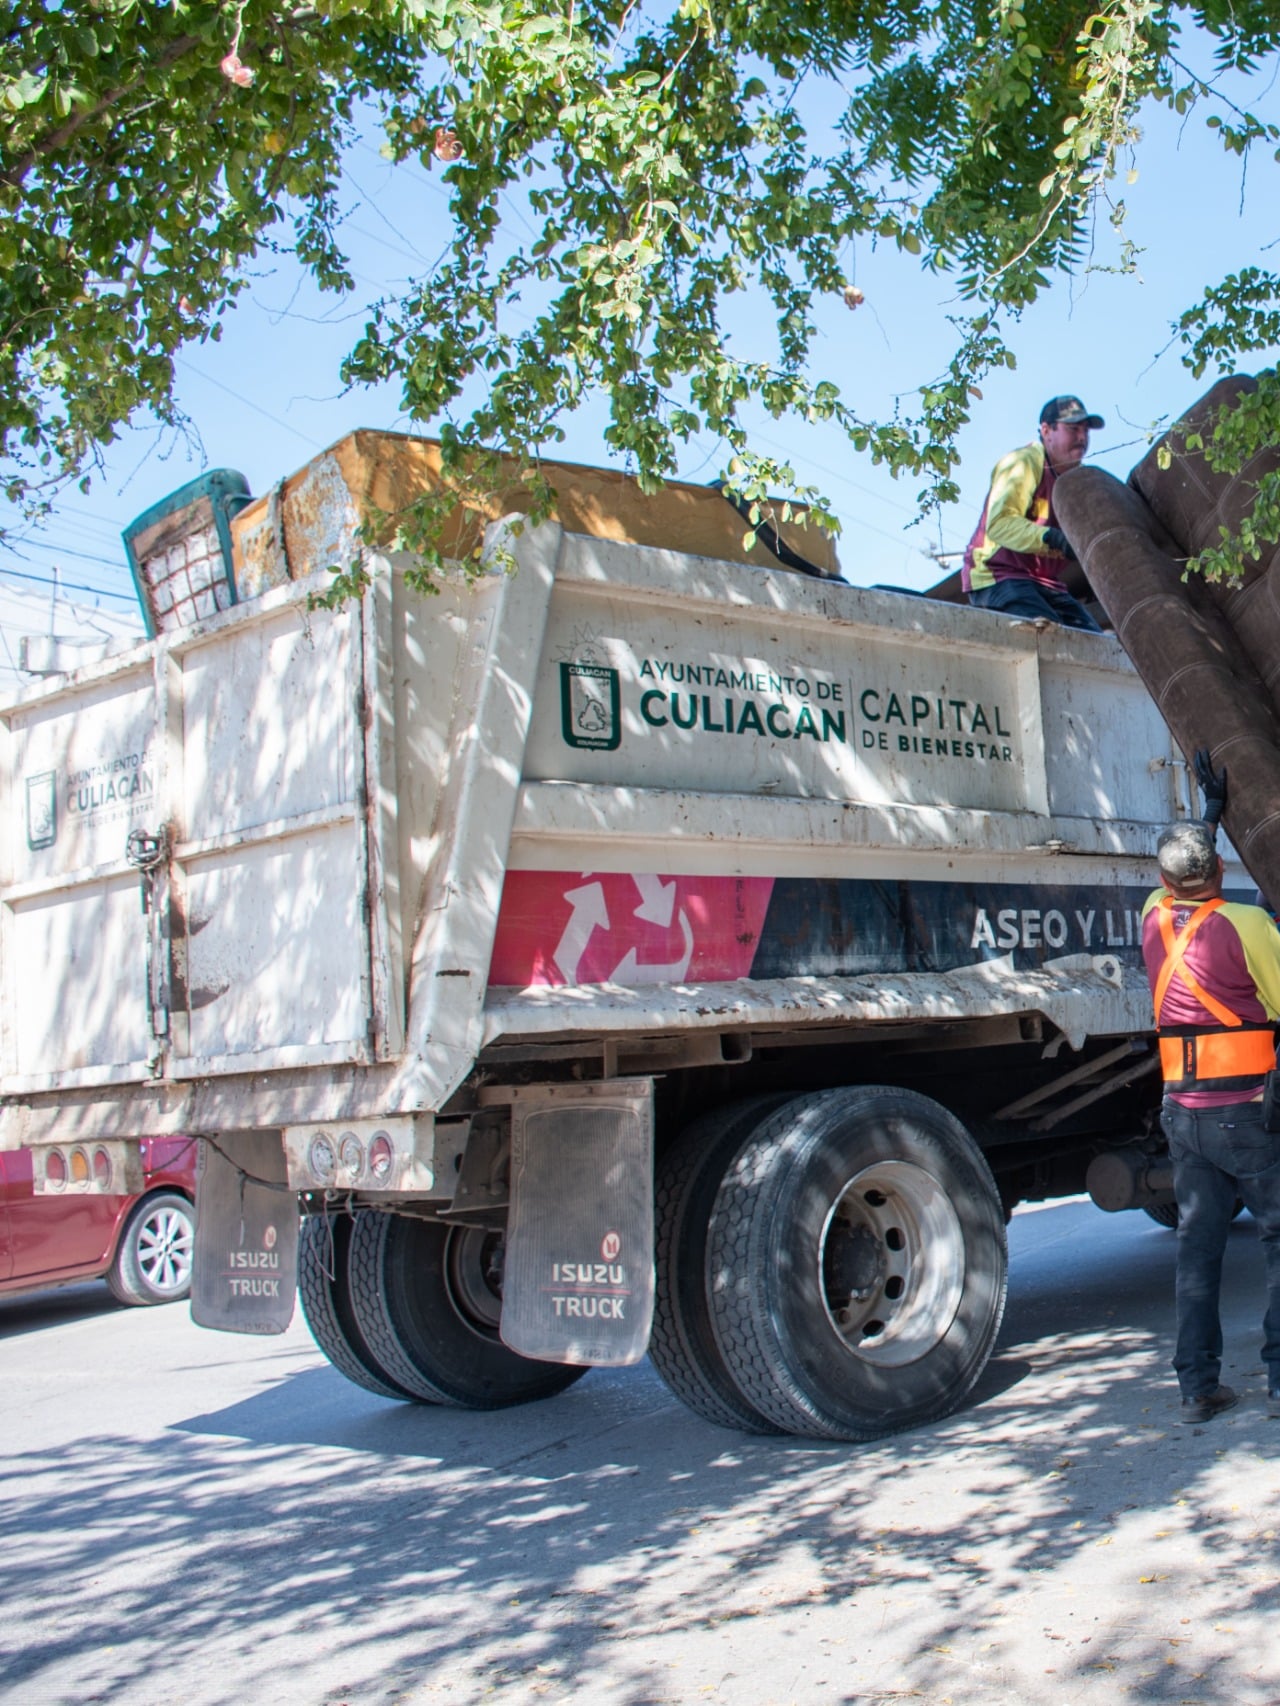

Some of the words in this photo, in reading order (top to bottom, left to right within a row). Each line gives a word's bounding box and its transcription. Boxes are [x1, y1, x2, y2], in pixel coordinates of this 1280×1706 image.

[639, 659, 810, 698] AYUNTAMIENTO
[816, 681, 843, 702] DE
[639, 688, 847, 744] CULIACÁN
[860, 689, 1011, 738] CAPITAL
[862, 729, 889, 751] DE
[898, 734, 1013, 763] BIENESTAR
[970, 908, 1068, 948] ASEO
[1075, 909, 1096, 947] Y
[1105, 909, 1143, 946] LI
[229, 1252, 279, 1268] ISUZU
[552, 1263, 623, 1284] ISUZU
[229, 1279, 279, 1297] TRUCK
[552, 1297, 625, 1319] TRUCK
